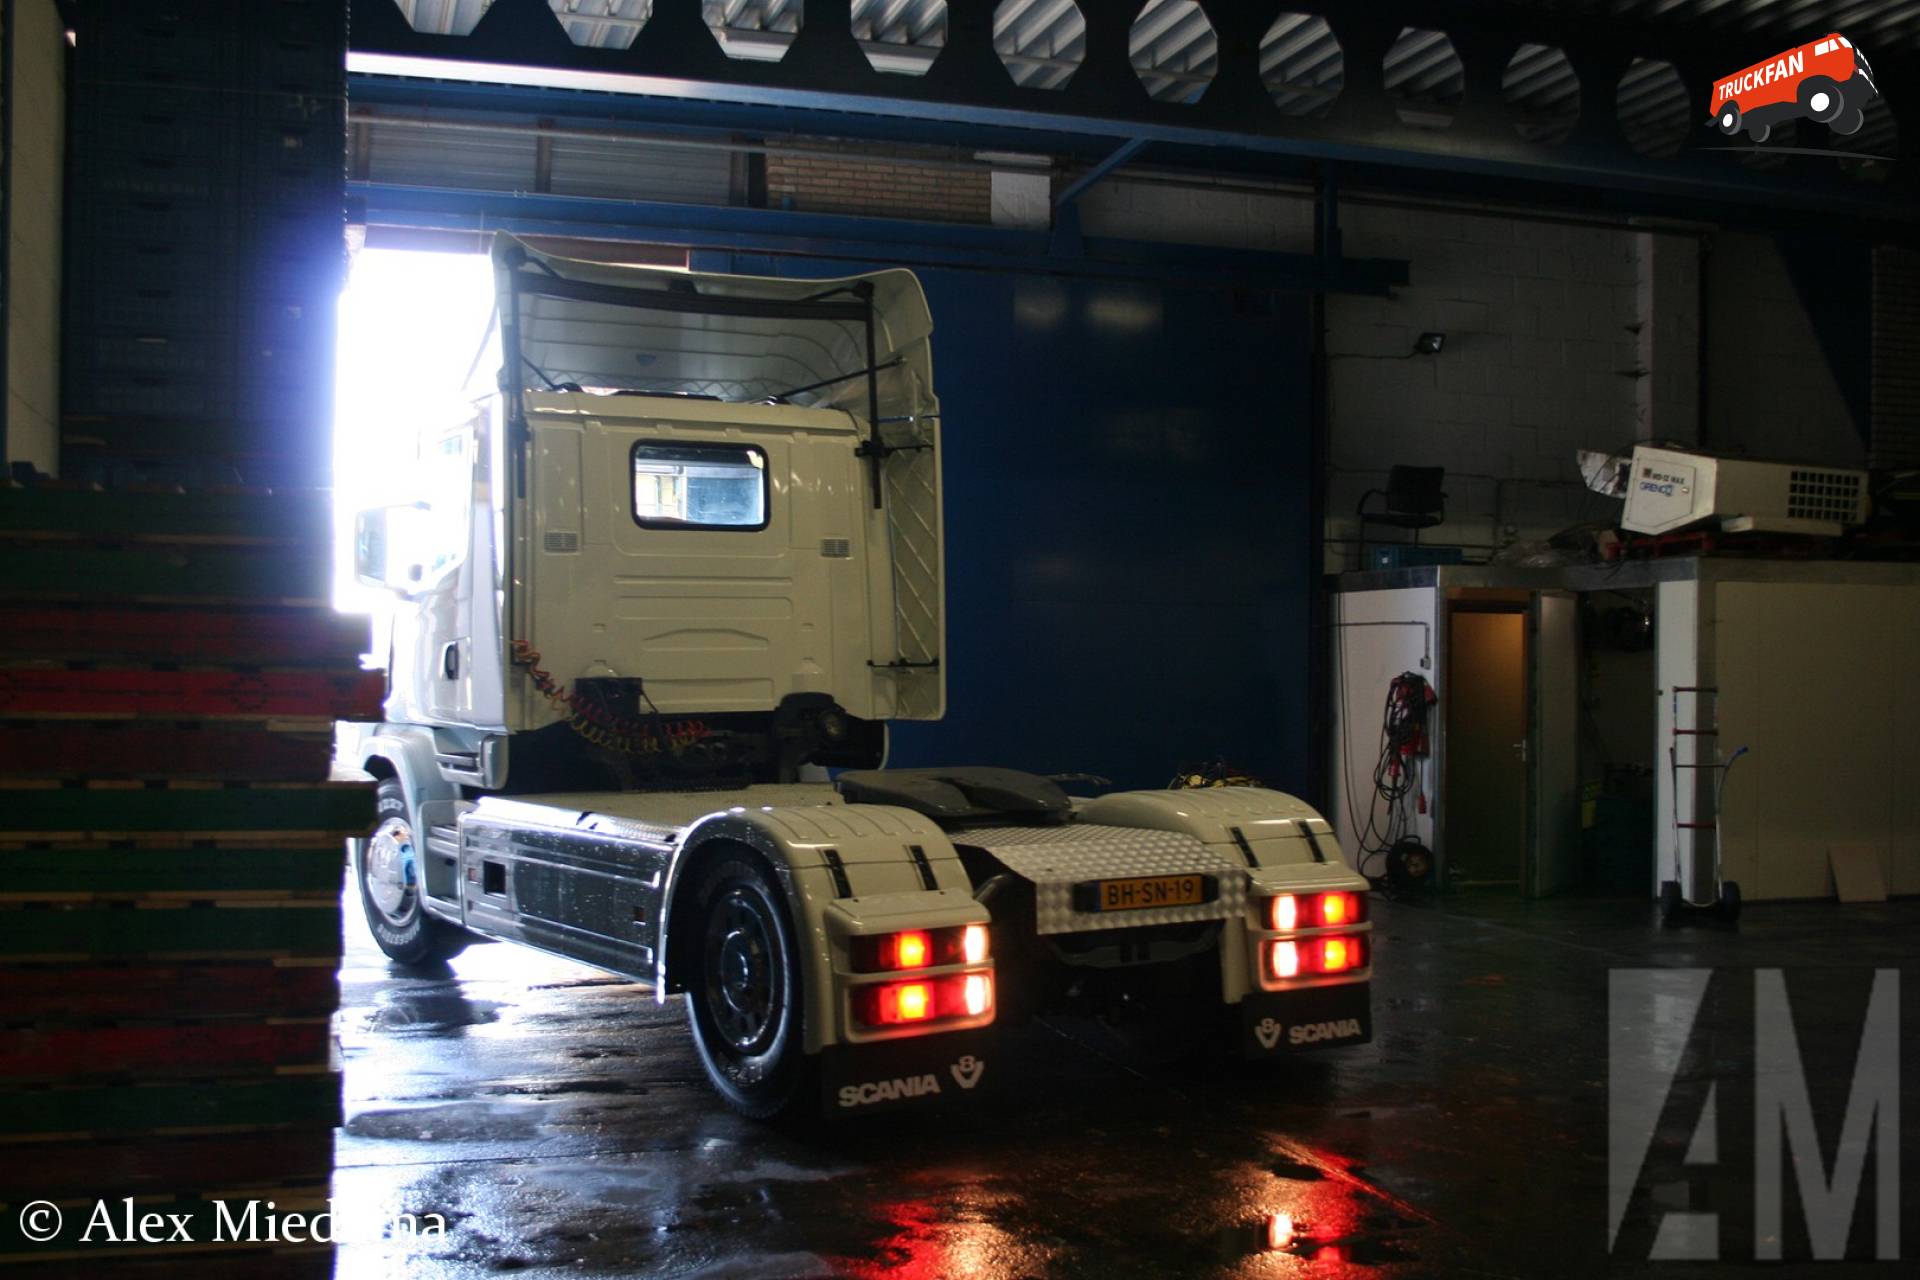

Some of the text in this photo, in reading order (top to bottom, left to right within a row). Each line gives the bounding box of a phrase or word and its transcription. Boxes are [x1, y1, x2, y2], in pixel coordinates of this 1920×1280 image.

[1107, 879, 1194, 904] BH-SN-19
[1289, 1018, 1361, 1044] SCANIA
[838, 1074, 942, 1107] SCANIA
